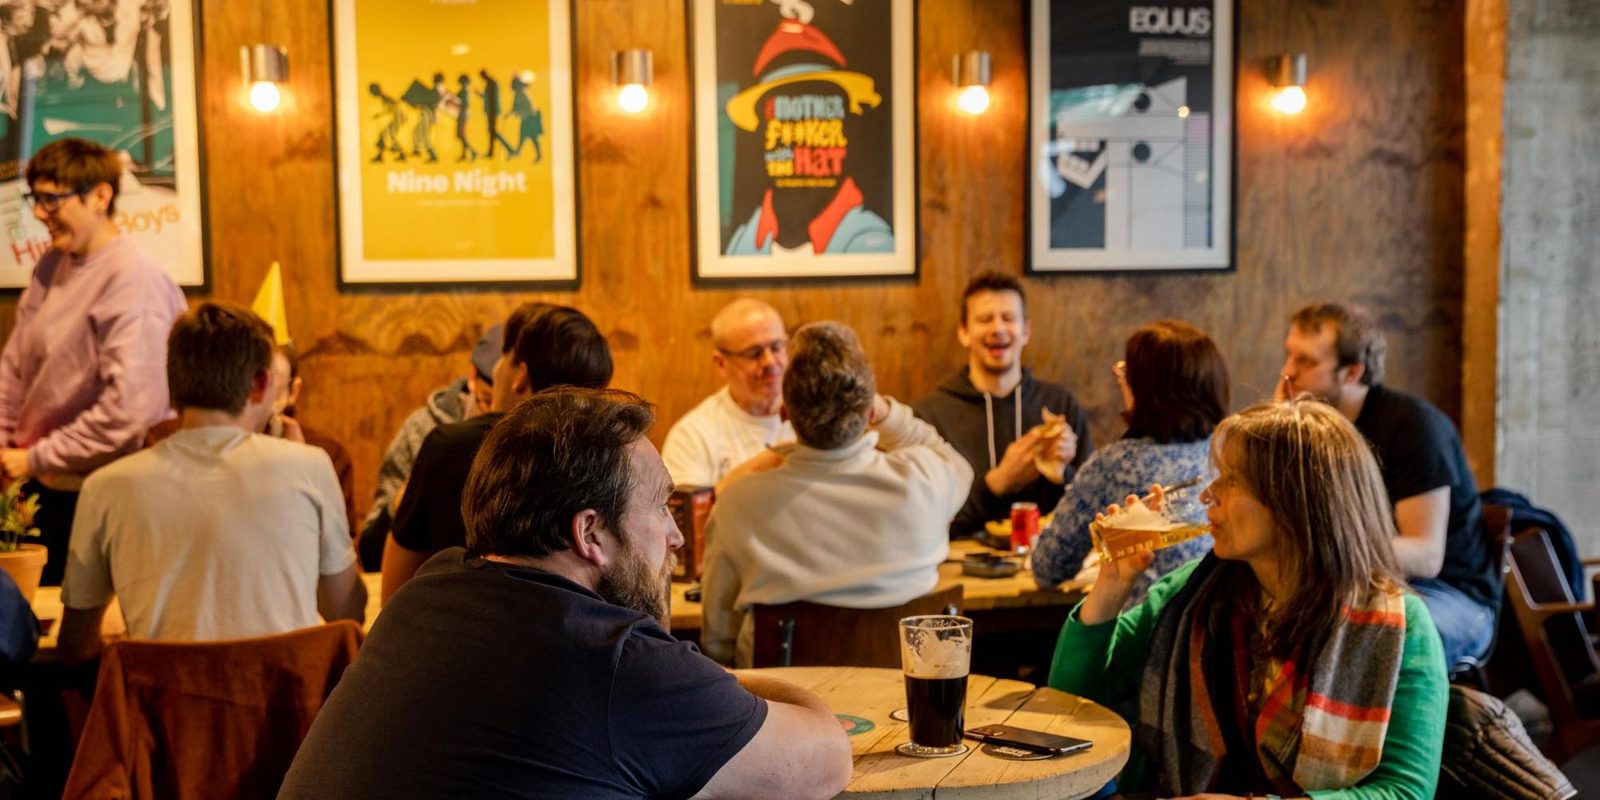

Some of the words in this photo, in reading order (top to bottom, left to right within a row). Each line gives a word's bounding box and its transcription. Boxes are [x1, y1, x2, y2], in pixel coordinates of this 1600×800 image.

[1129, 6, 1212, 35] EQUUS
[387, 168, 449, 193] Nine
[454, 168, 528, 198] Night
